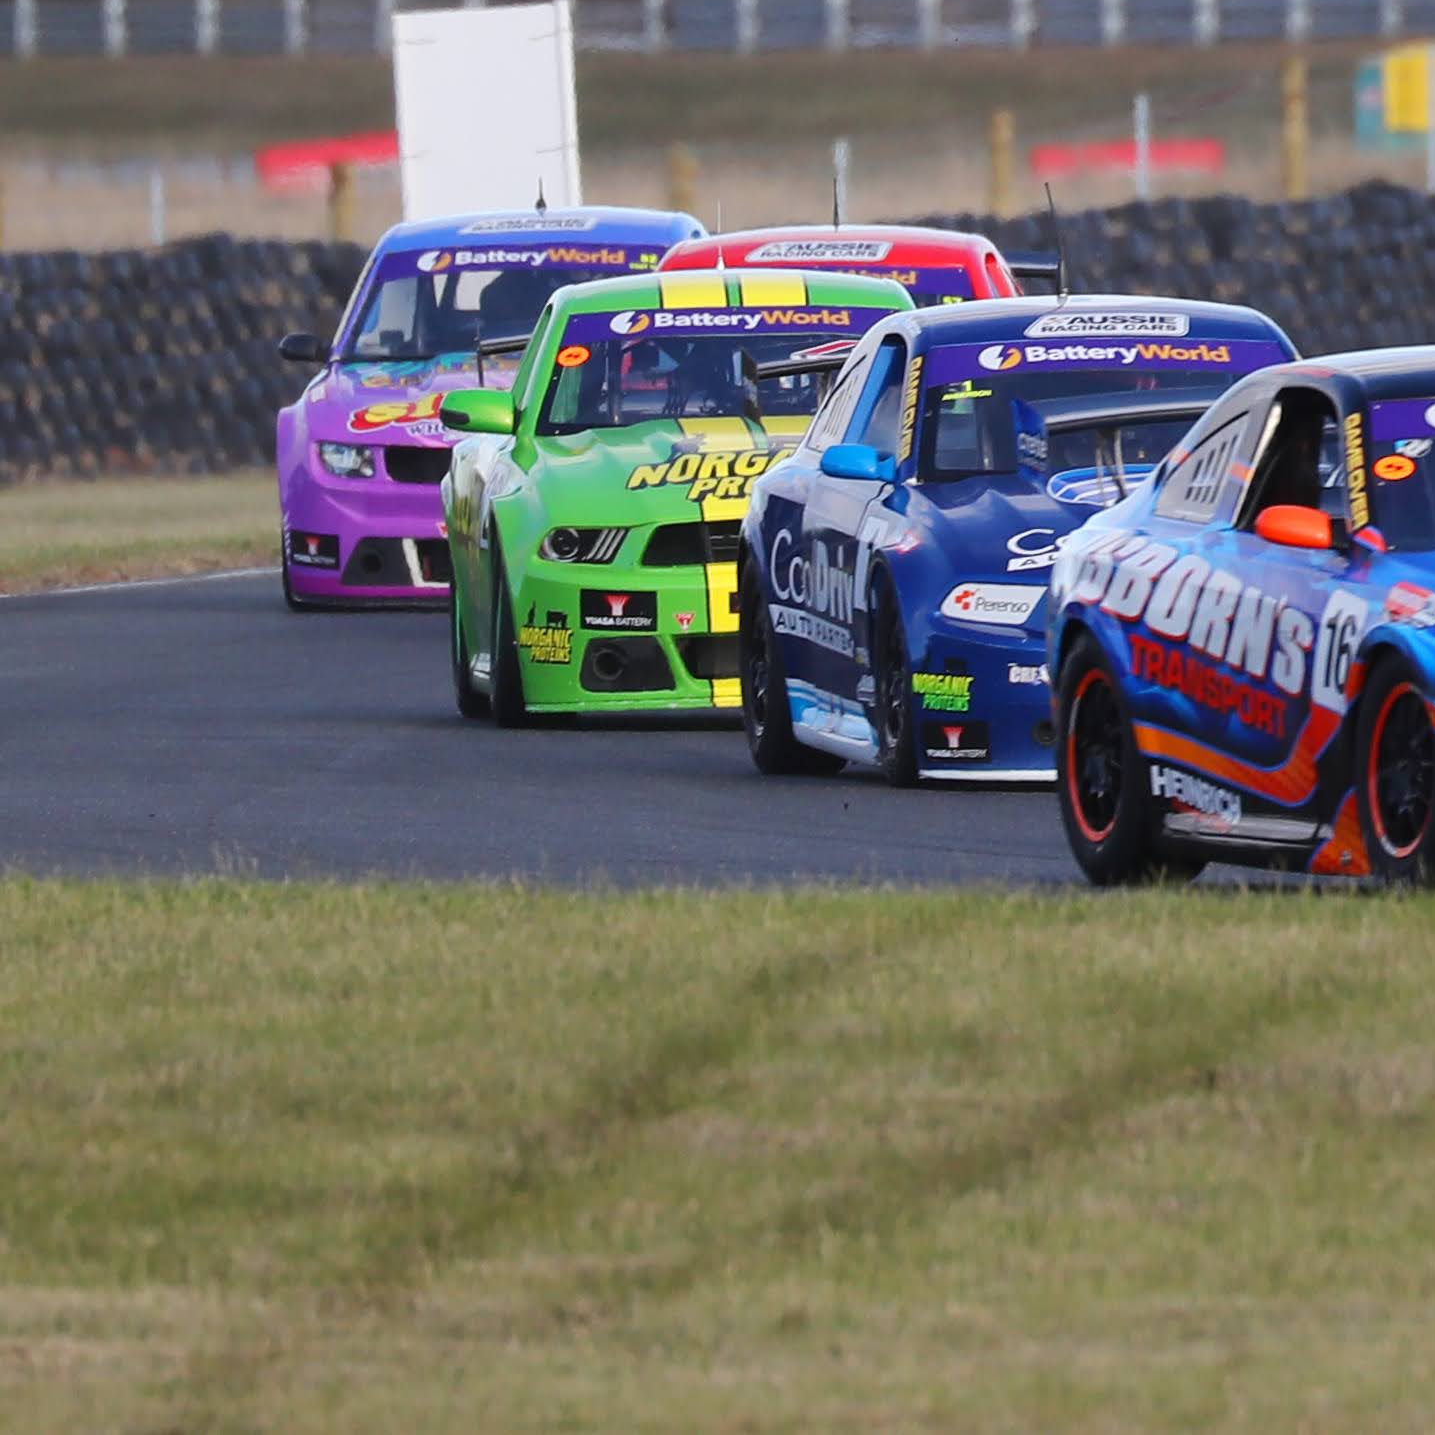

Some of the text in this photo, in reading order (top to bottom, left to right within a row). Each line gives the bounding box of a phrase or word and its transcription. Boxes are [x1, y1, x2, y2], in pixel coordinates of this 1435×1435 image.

[455, 247, 626, 266] BatteryWorld
[653, 310, 851, 329] BatteryWorld
[1041, 321, 1177, 334] RACING CARS
[1066, 314, 1176, 325] AUSSIE
[1025, 343, 1232, 365] BatteryWorld
[974, 597, 1029, 613] Perenso
[519, 628, 574, 649] NORGANIC
[1323, 607, 1359, 695] 16
[1129, 633, 1288, 739] TRANSPORT
